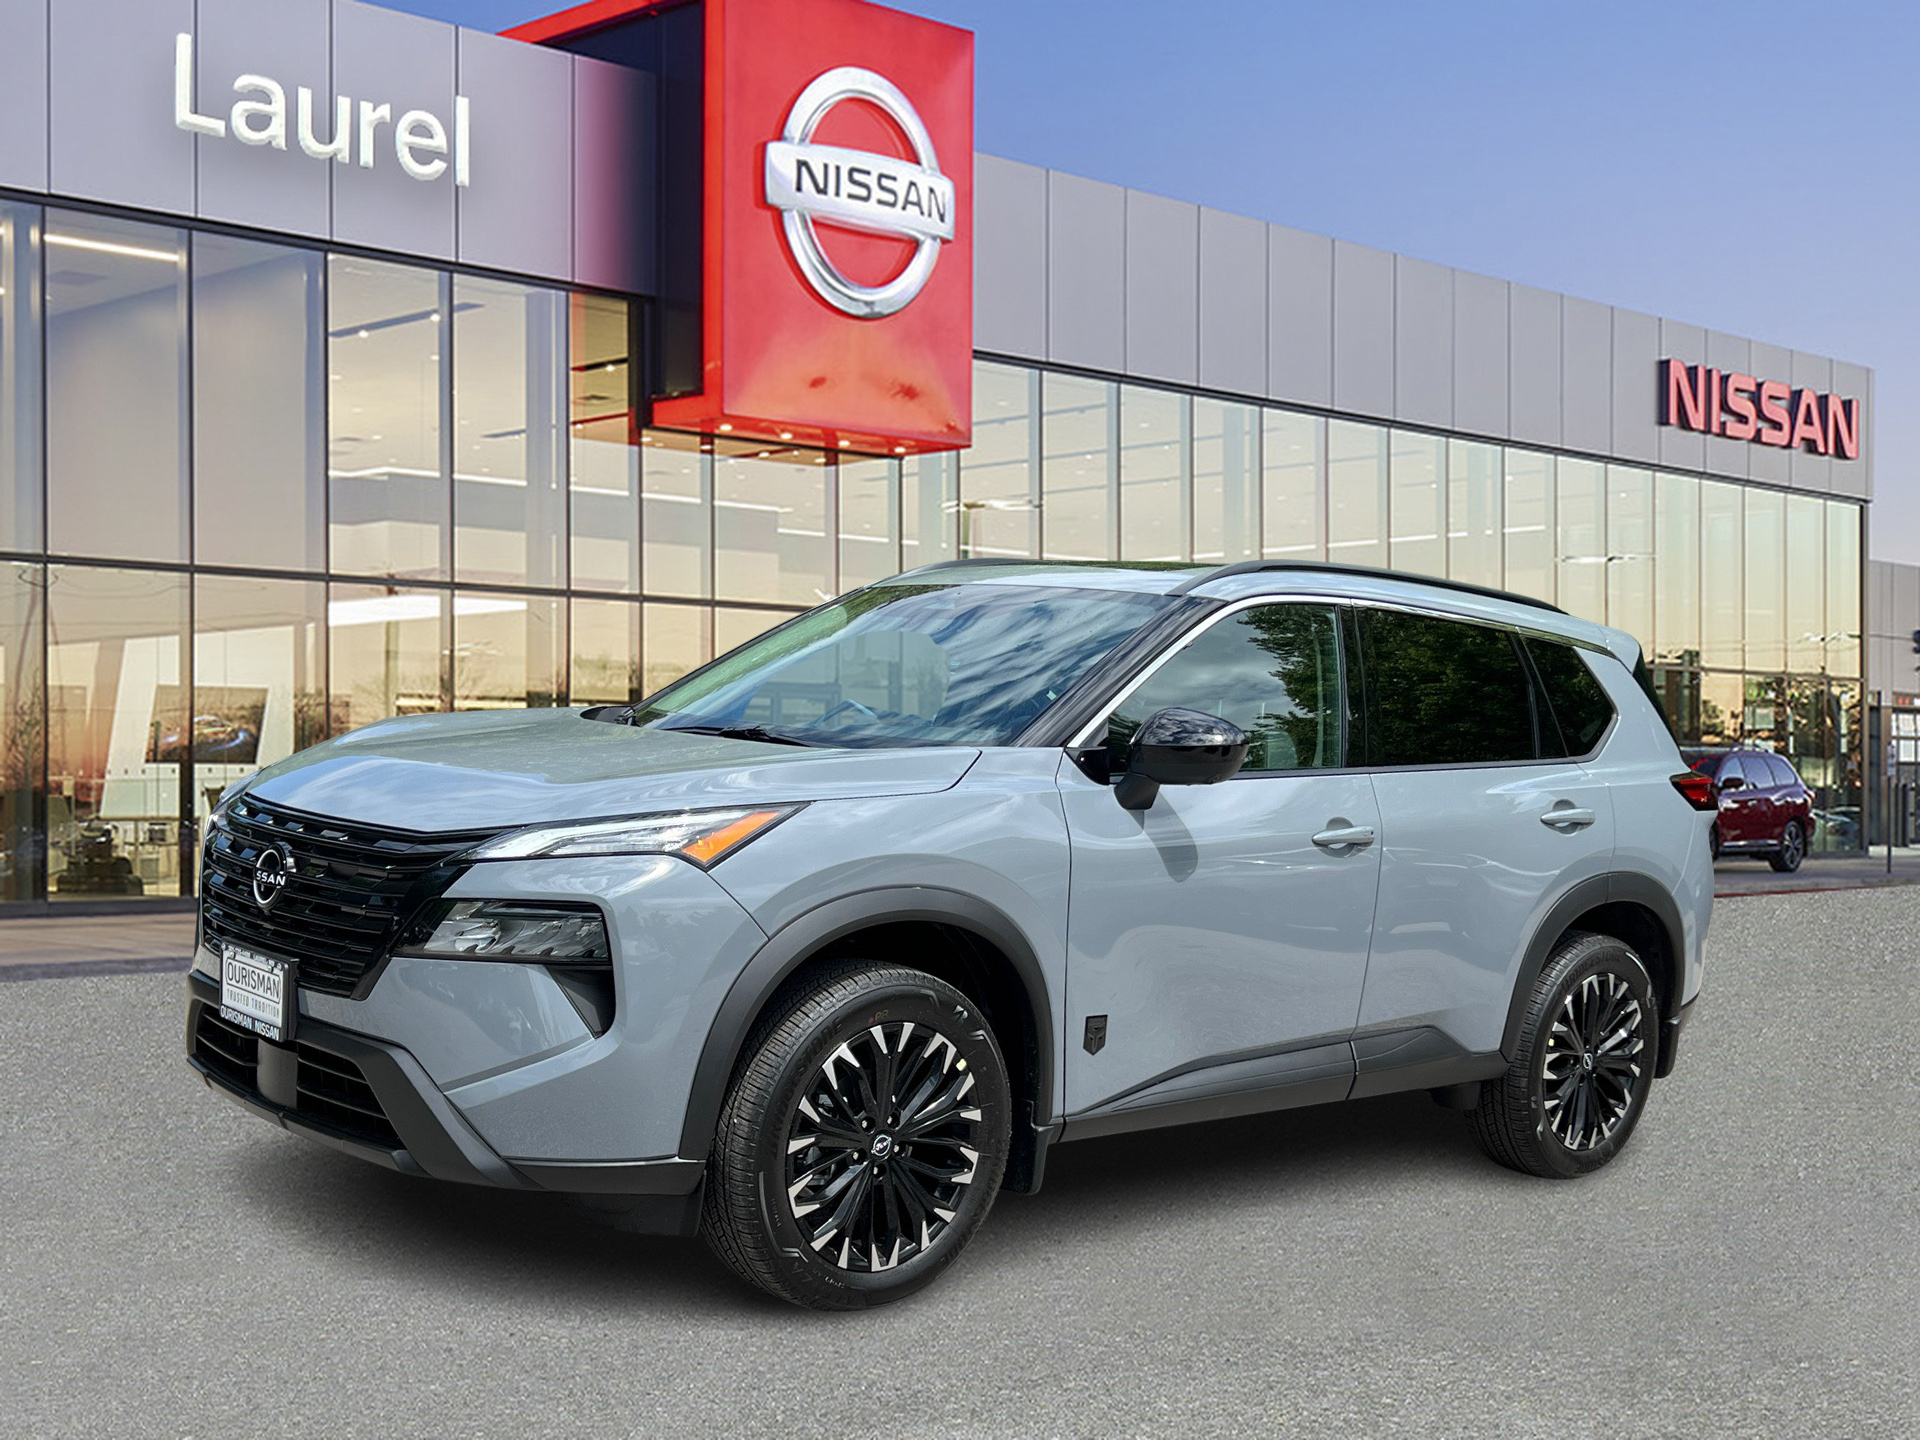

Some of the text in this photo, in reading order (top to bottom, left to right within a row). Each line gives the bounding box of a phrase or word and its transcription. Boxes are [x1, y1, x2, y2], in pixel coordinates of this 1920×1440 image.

[175, 33, 470, 188] Laurel
[794, 158, 947, 224] NISSAN
[1659, 358, 1860, 460] NISSAN
[227, 961, 280, 1000] OURISMAN
[227, 988, 280, 1019] TRUSTED TRADITION
[220, 1005, 280, 1041] OURISMAN NISSAN
